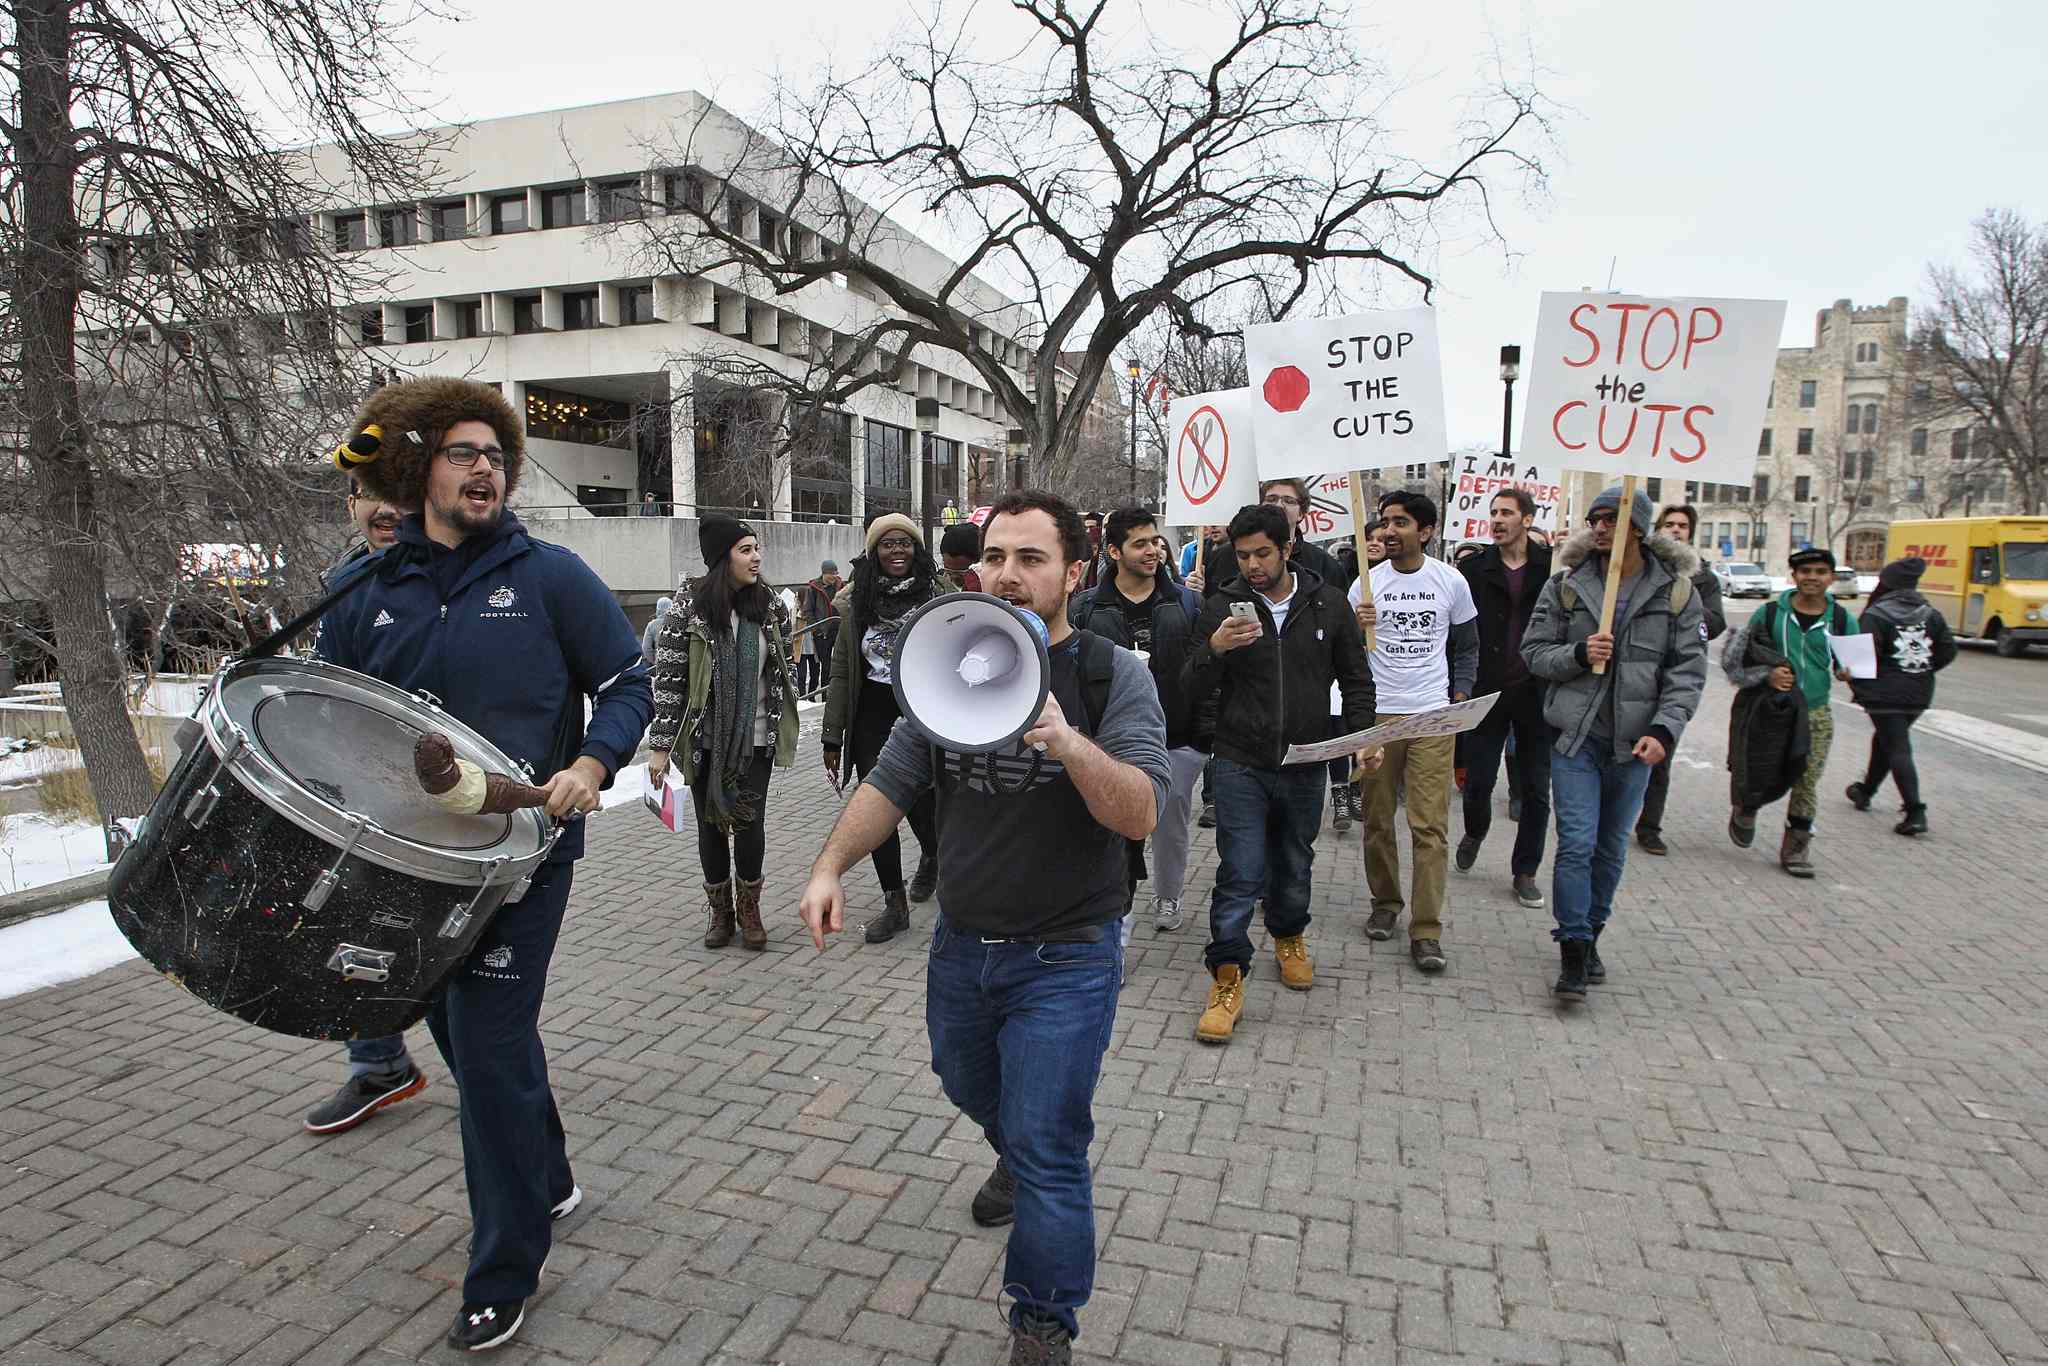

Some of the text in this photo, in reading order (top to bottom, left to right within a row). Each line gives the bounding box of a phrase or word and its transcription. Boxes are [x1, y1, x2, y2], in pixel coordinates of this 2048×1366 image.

[1327, 332, 1414, 368] STOP
[1563, 303, 1723, 371] STOP
[1343, 376, 1399, 402] THE
[1595, 374, 1646, 403] the
[1333, 409, 1414, 438] CUTS
[1552, 400, 1714, 463] CUTS
[1462, 455, 1538, 480] I AM A
[1320, 476, 1349, 494] THE
[1459, 495, 1482, 511] OF
[1384, 591, 1436, 601] We Are Not
[1385, 644, 1405, 654] Cash
